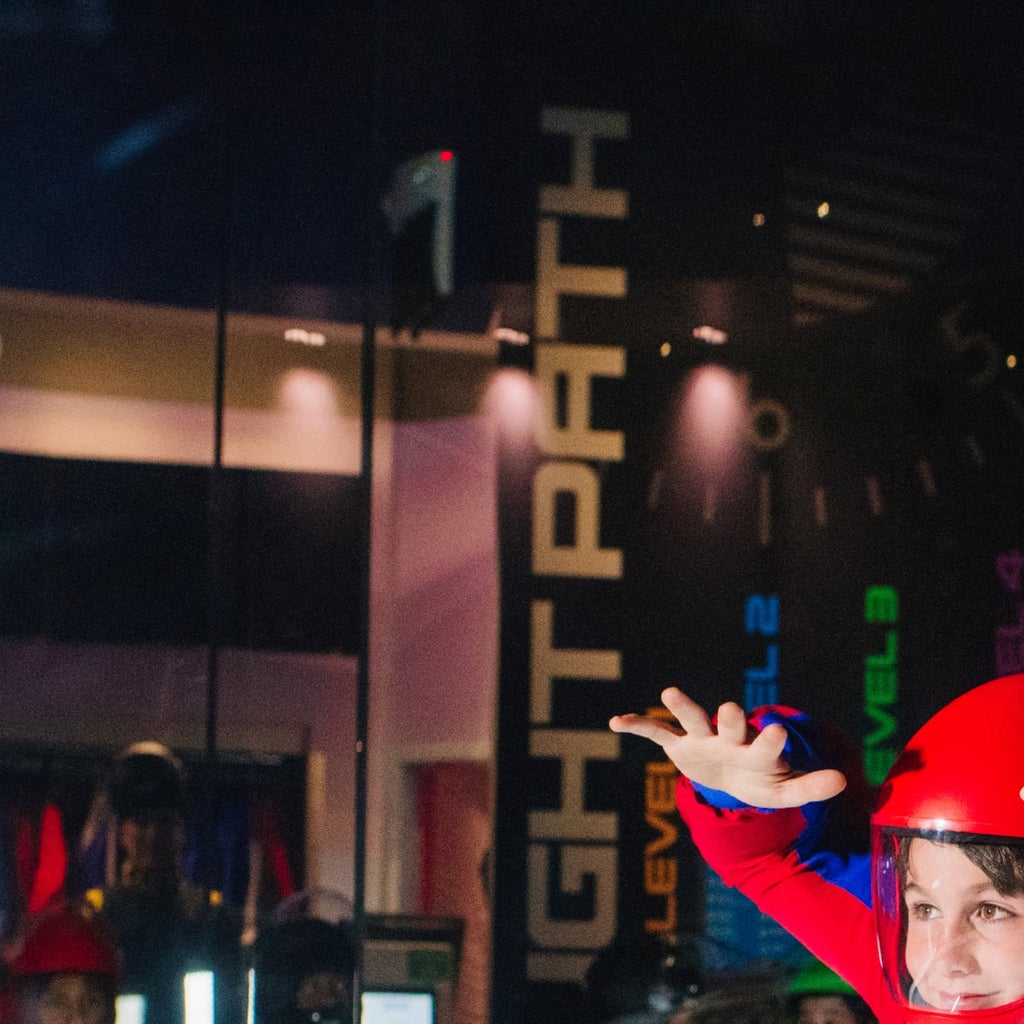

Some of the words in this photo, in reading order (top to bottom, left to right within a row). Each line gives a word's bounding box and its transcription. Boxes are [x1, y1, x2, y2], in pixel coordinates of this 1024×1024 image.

[531, 107, 630, 578] PATH
[526, 600, 622, 983] IGHT
[863, 631, 900, 785] EVEL
